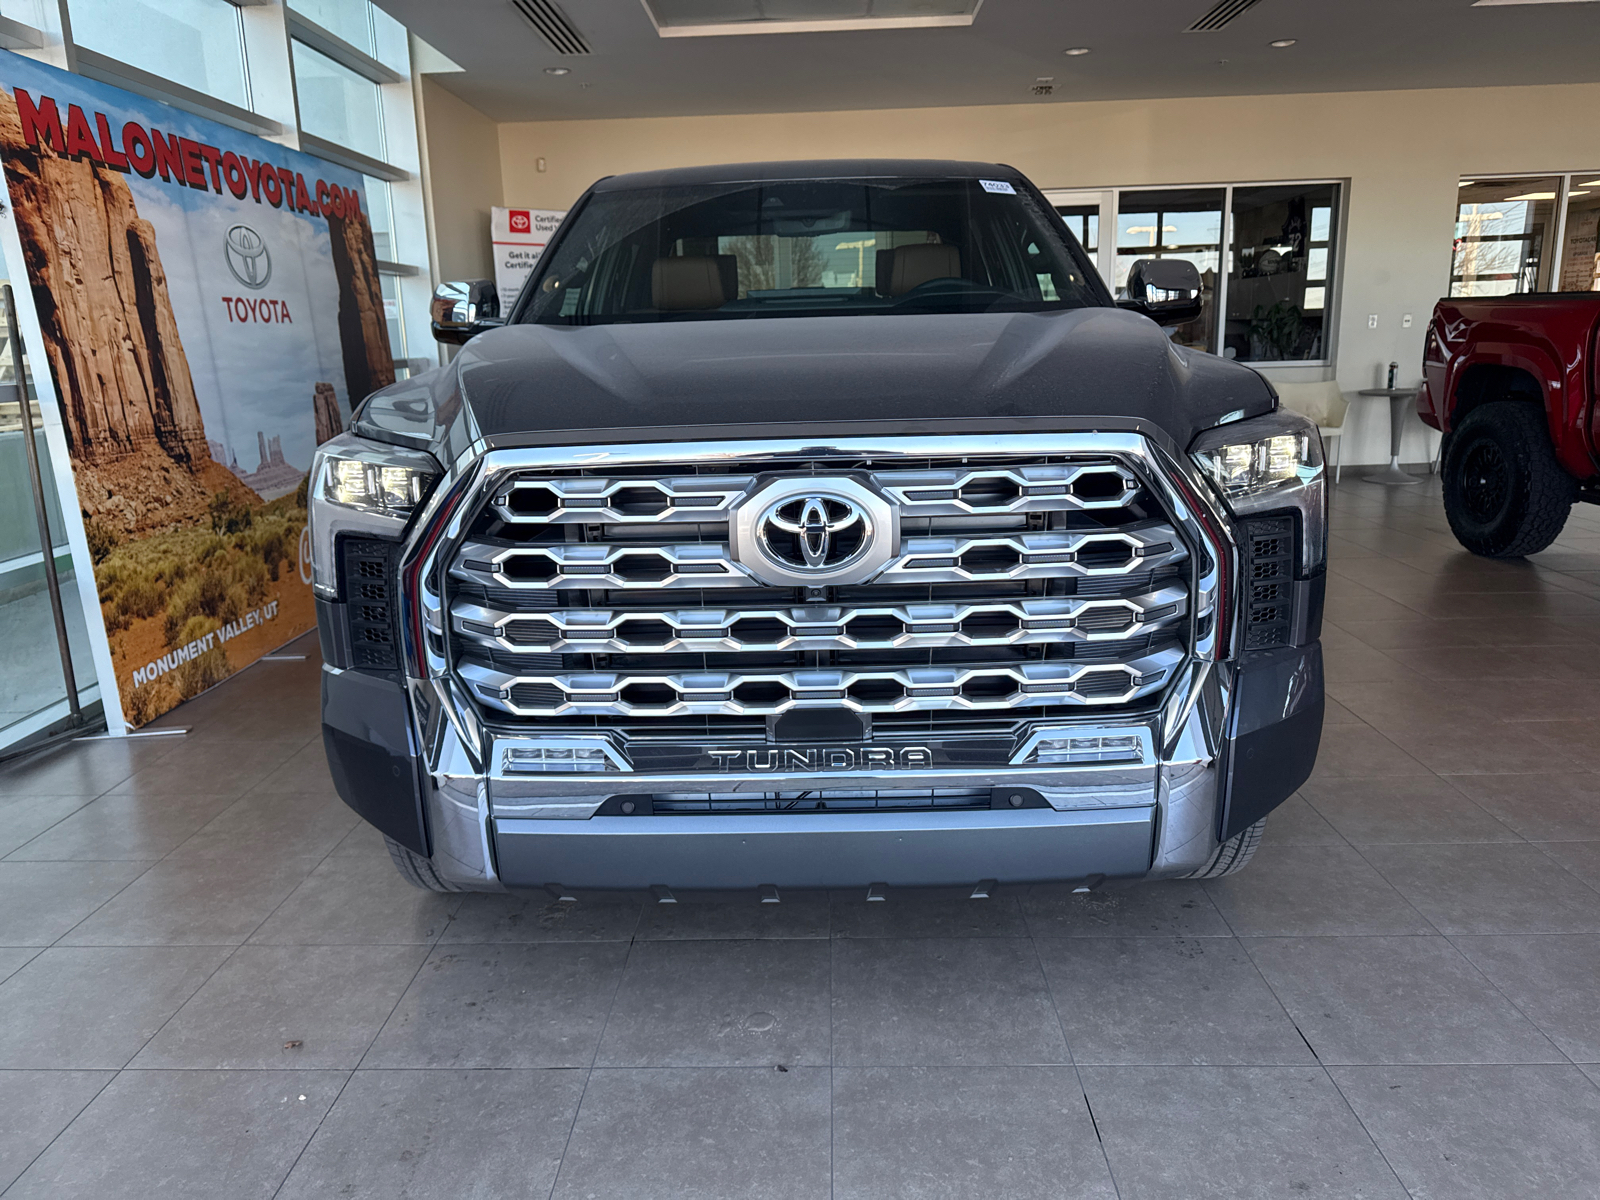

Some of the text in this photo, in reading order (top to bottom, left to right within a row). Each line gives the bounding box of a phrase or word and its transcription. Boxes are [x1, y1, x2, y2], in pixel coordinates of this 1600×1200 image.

[13, 87, 364, 221] MALONETOYOTA.COM
[504, 261, 533, 269] Certifie
[508, 251, 541, 259] Get it al
[222, 297, 292, 324] TOYOTA
[132, 601, 279, 688] MONUMENT VALLEY, UT
[708, 746, 934, 773] TUNDRA
